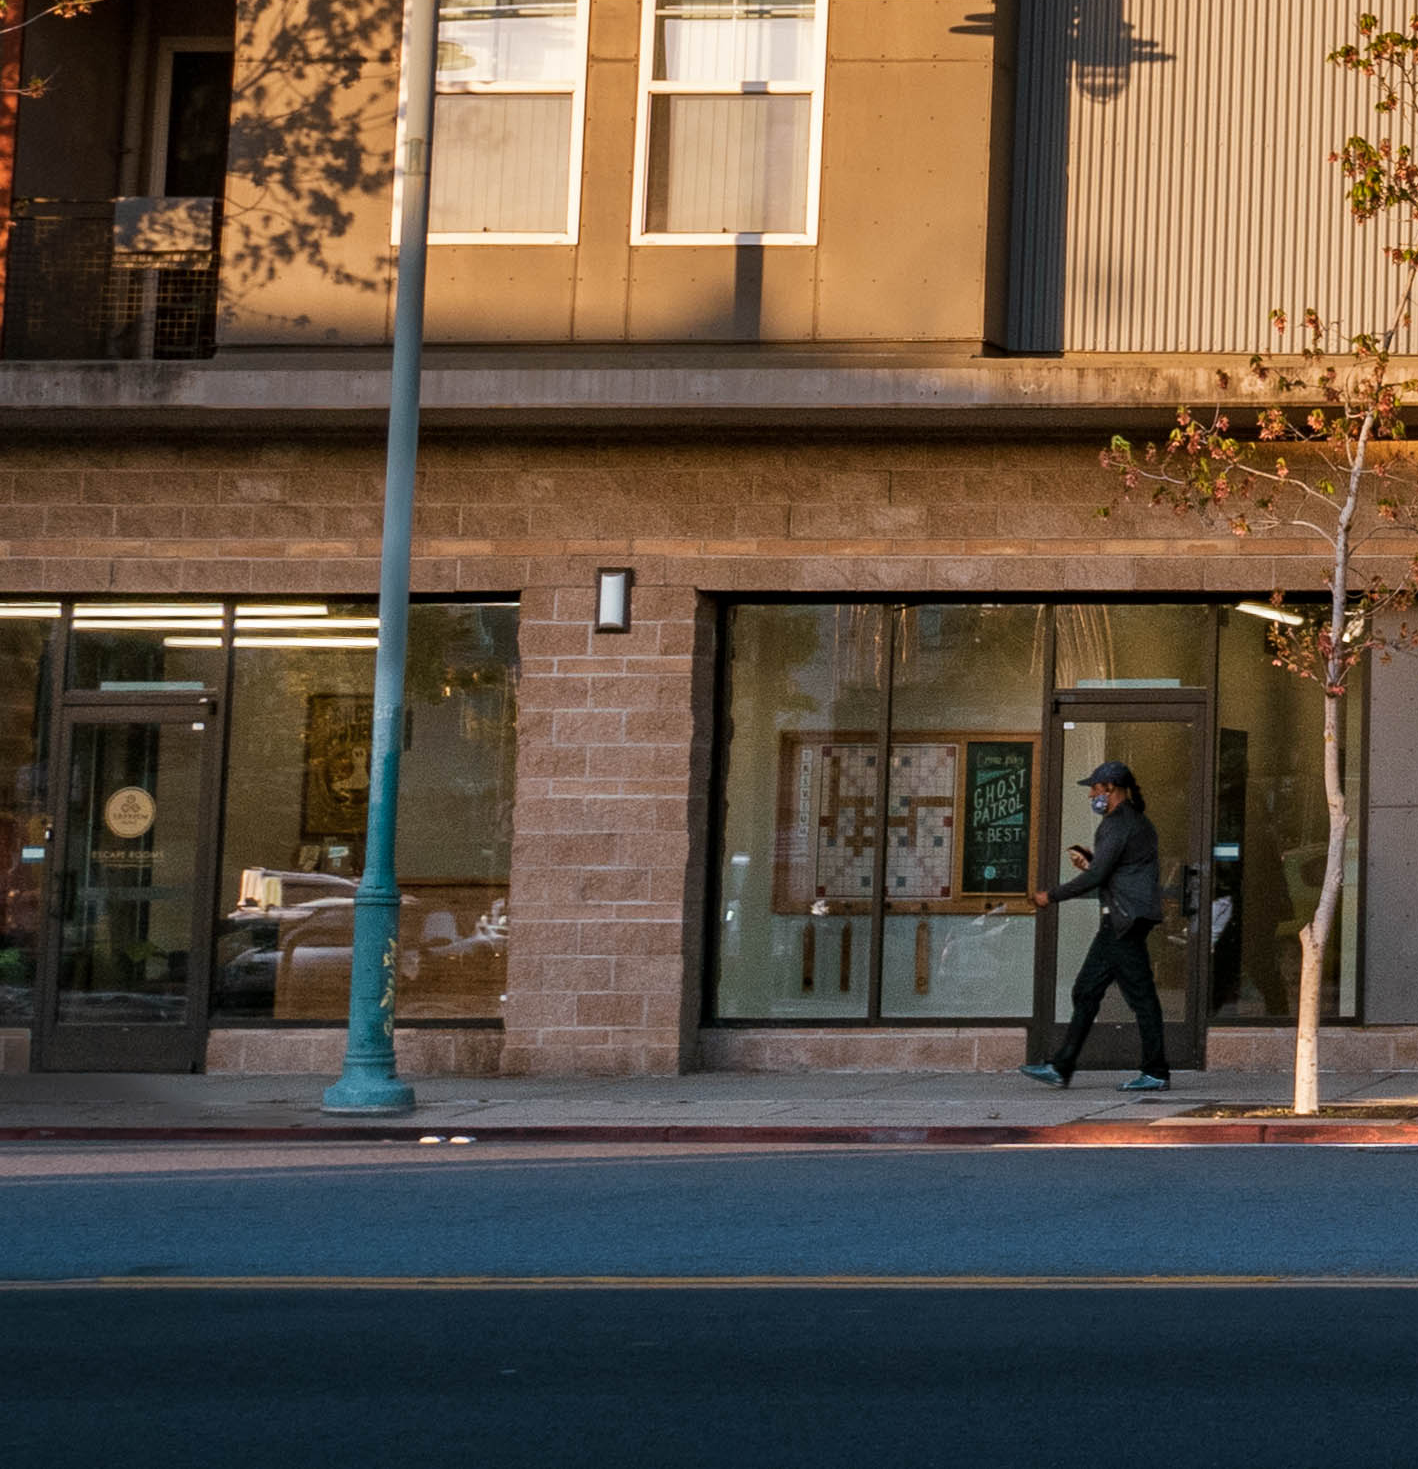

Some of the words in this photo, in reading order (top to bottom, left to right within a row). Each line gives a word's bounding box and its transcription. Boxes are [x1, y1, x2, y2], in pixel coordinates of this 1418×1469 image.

[974, 769, 1026, 809] GHOST
[973, 793, 1024, 827] PATROL
[987, 828, 1022, 843] BEST
